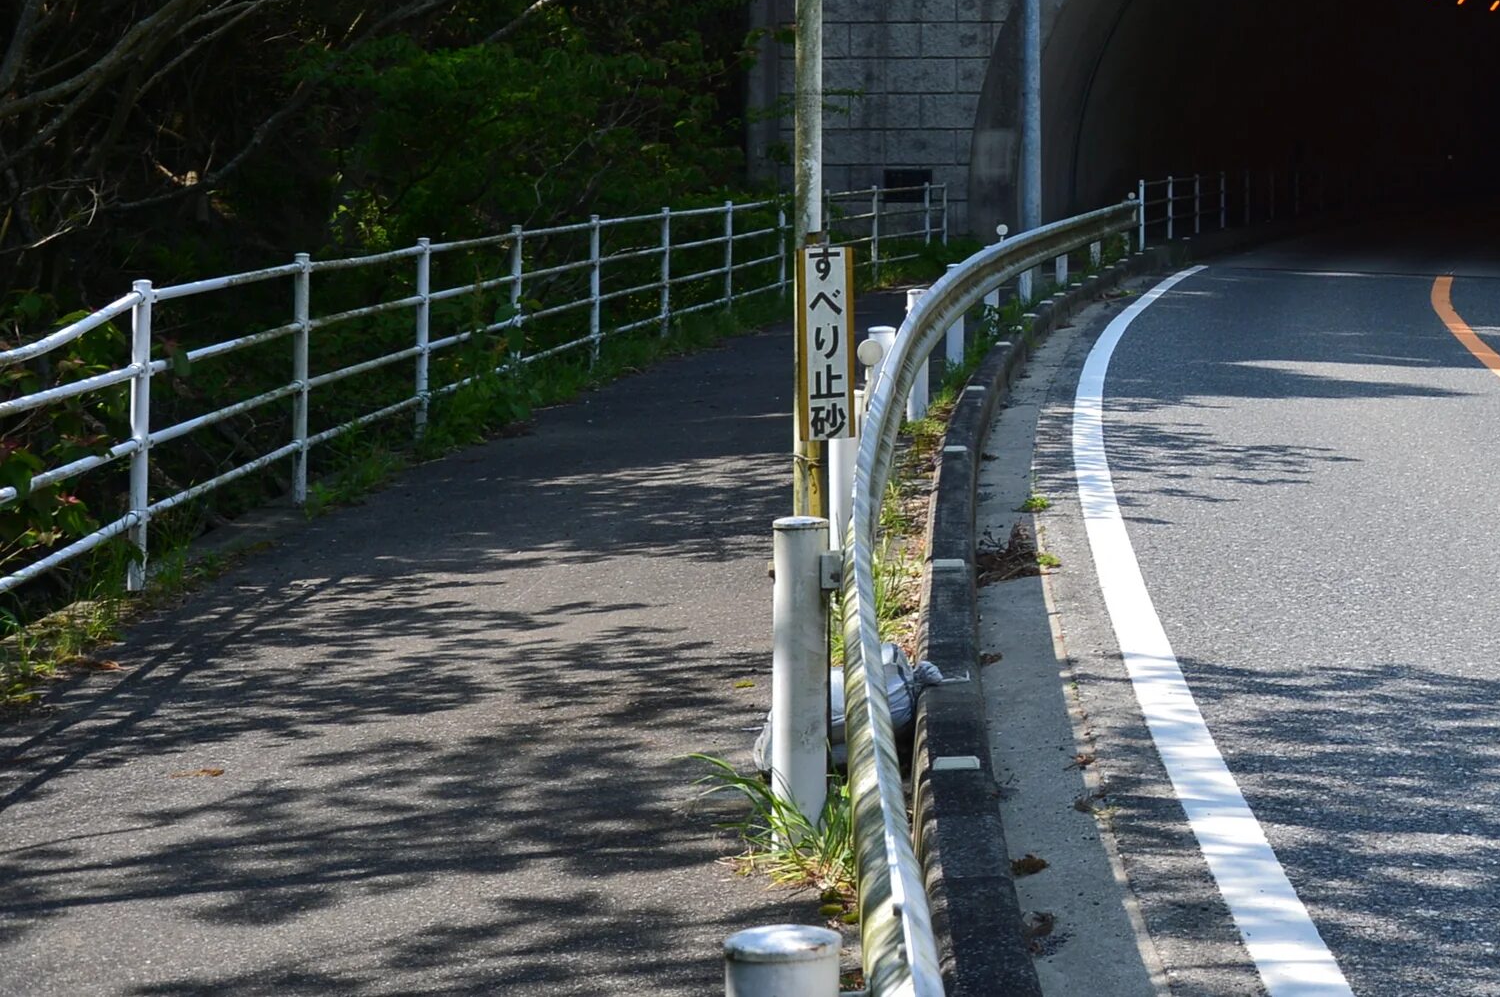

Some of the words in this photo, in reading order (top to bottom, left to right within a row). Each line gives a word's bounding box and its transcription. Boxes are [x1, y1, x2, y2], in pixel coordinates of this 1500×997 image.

[808, 247, 846, 438] すべり止砂
